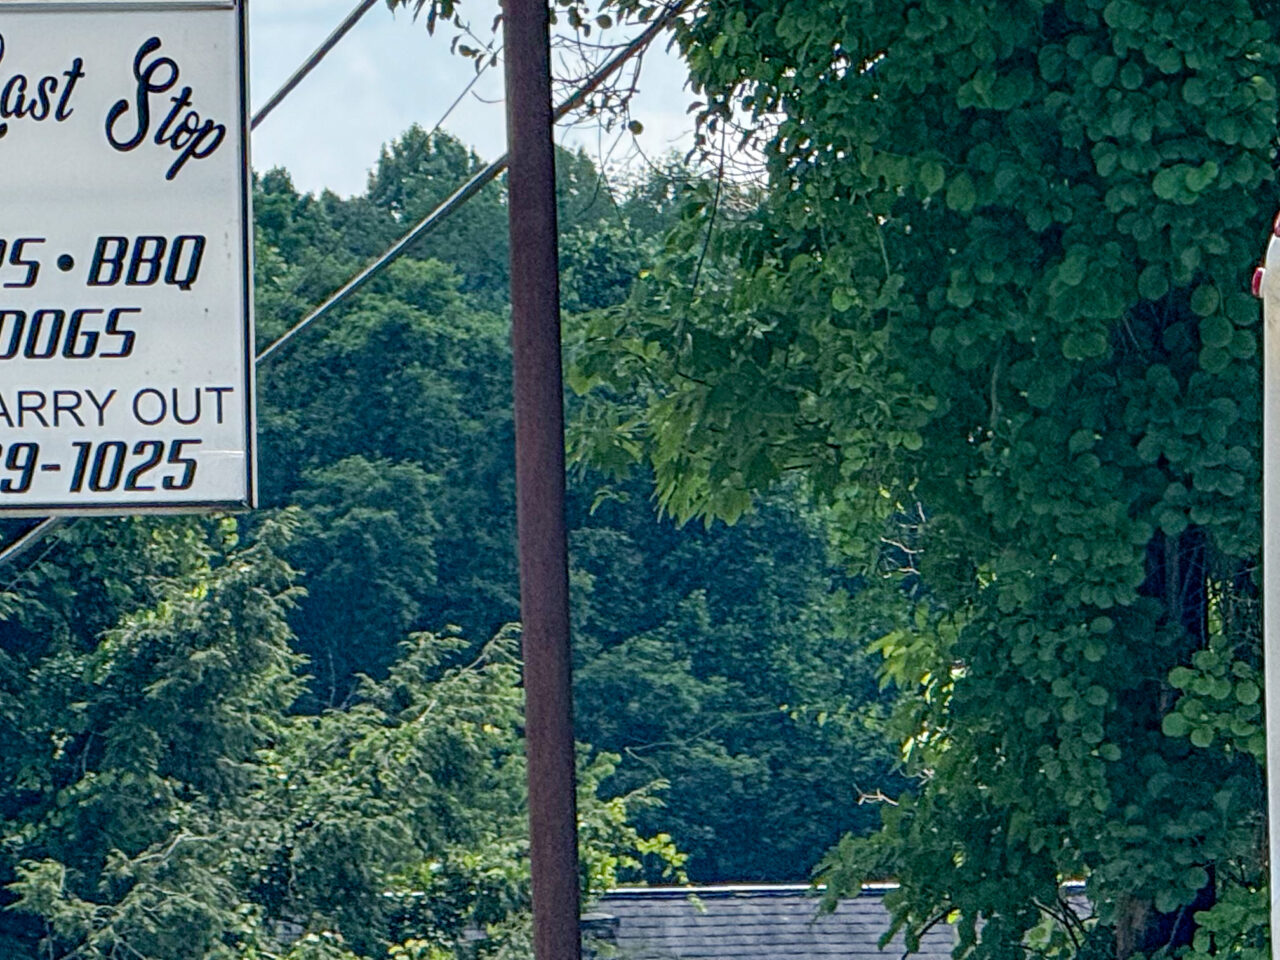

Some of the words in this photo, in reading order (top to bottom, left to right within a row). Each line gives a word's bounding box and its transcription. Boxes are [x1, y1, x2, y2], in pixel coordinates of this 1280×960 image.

[105, 37, 227, 180] Stop
[86, 235, 206, 291] BBQ
[132, 386, 235, 425] OUT
